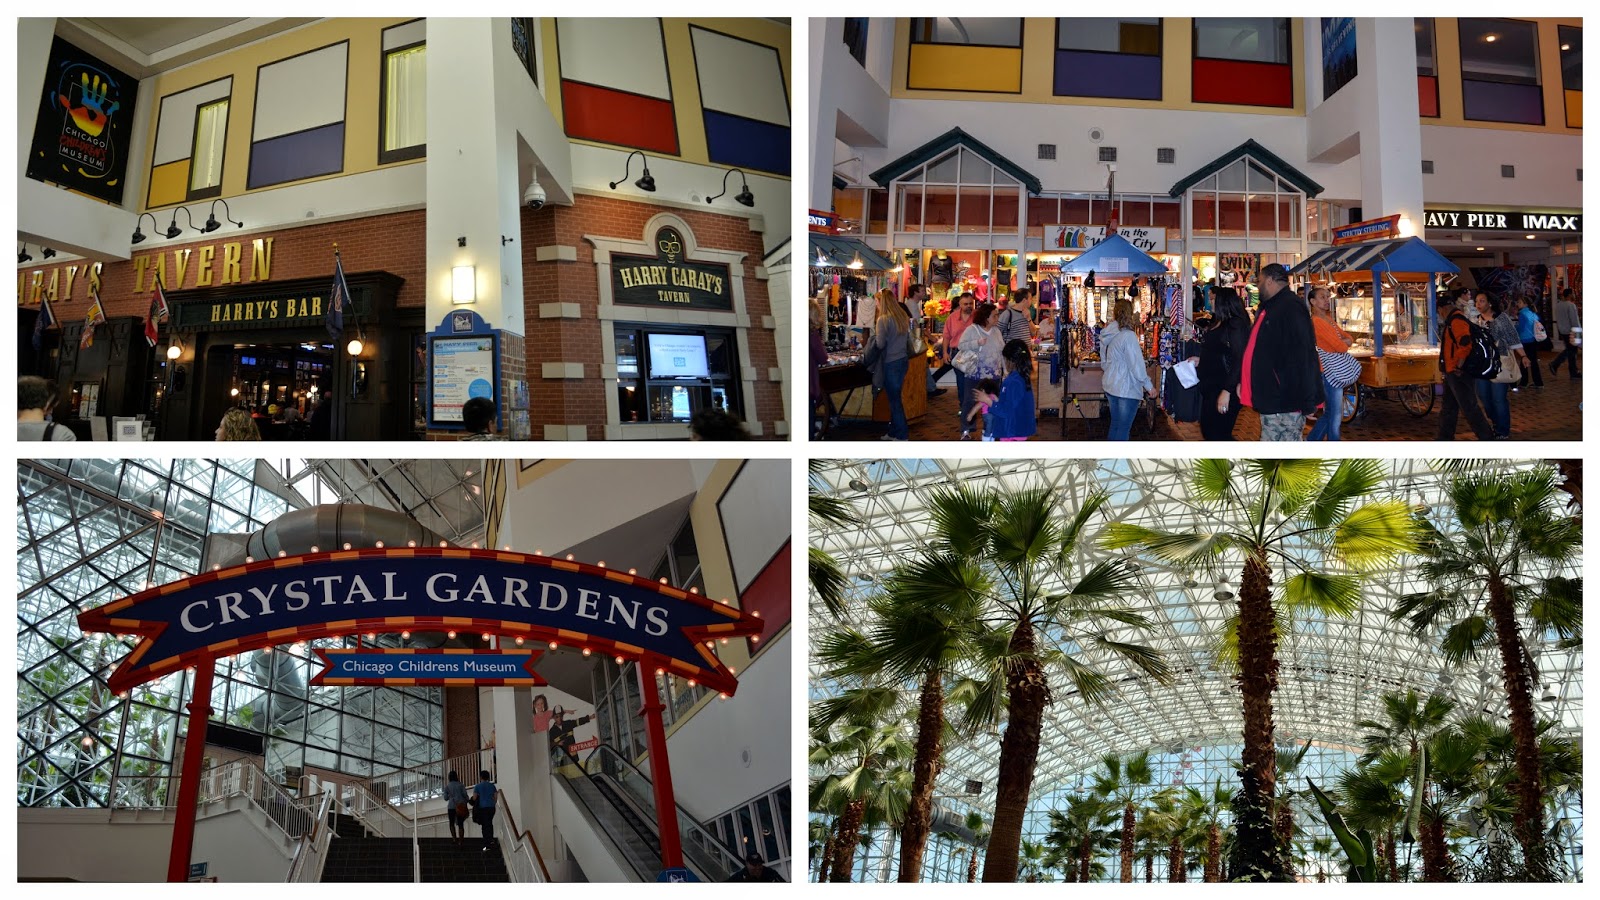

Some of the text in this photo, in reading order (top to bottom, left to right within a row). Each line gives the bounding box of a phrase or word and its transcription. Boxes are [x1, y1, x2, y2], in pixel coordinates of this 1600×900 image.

[65, 127, 106, 147] CHICAGO
[61, 146, 102, 167] MUSEUM
[1363, 223, 1389, 233] STERLING
[1467, 213, 1507, 228] PIER
[1523, 215, 1577, 230] IMAX
[1120, 229, 1131, 238] in
[1133, 229, 1149, 238] the
[1132, 238, 1156, 251] City
[133, 237, 274, 293] TAVERN
[619, 265, 723, 296] HARRY CARAY'S
[658, 290, 690, 304] TAVERN
[211, 296, 322, 322] HARRY'S BAR
[180, 571, 670, 637] CRYSTAL GARDENS
[342, 660, 517, 675] Chicago Childrens Museum
[570, 741, 598, 751] ENTRANCE
